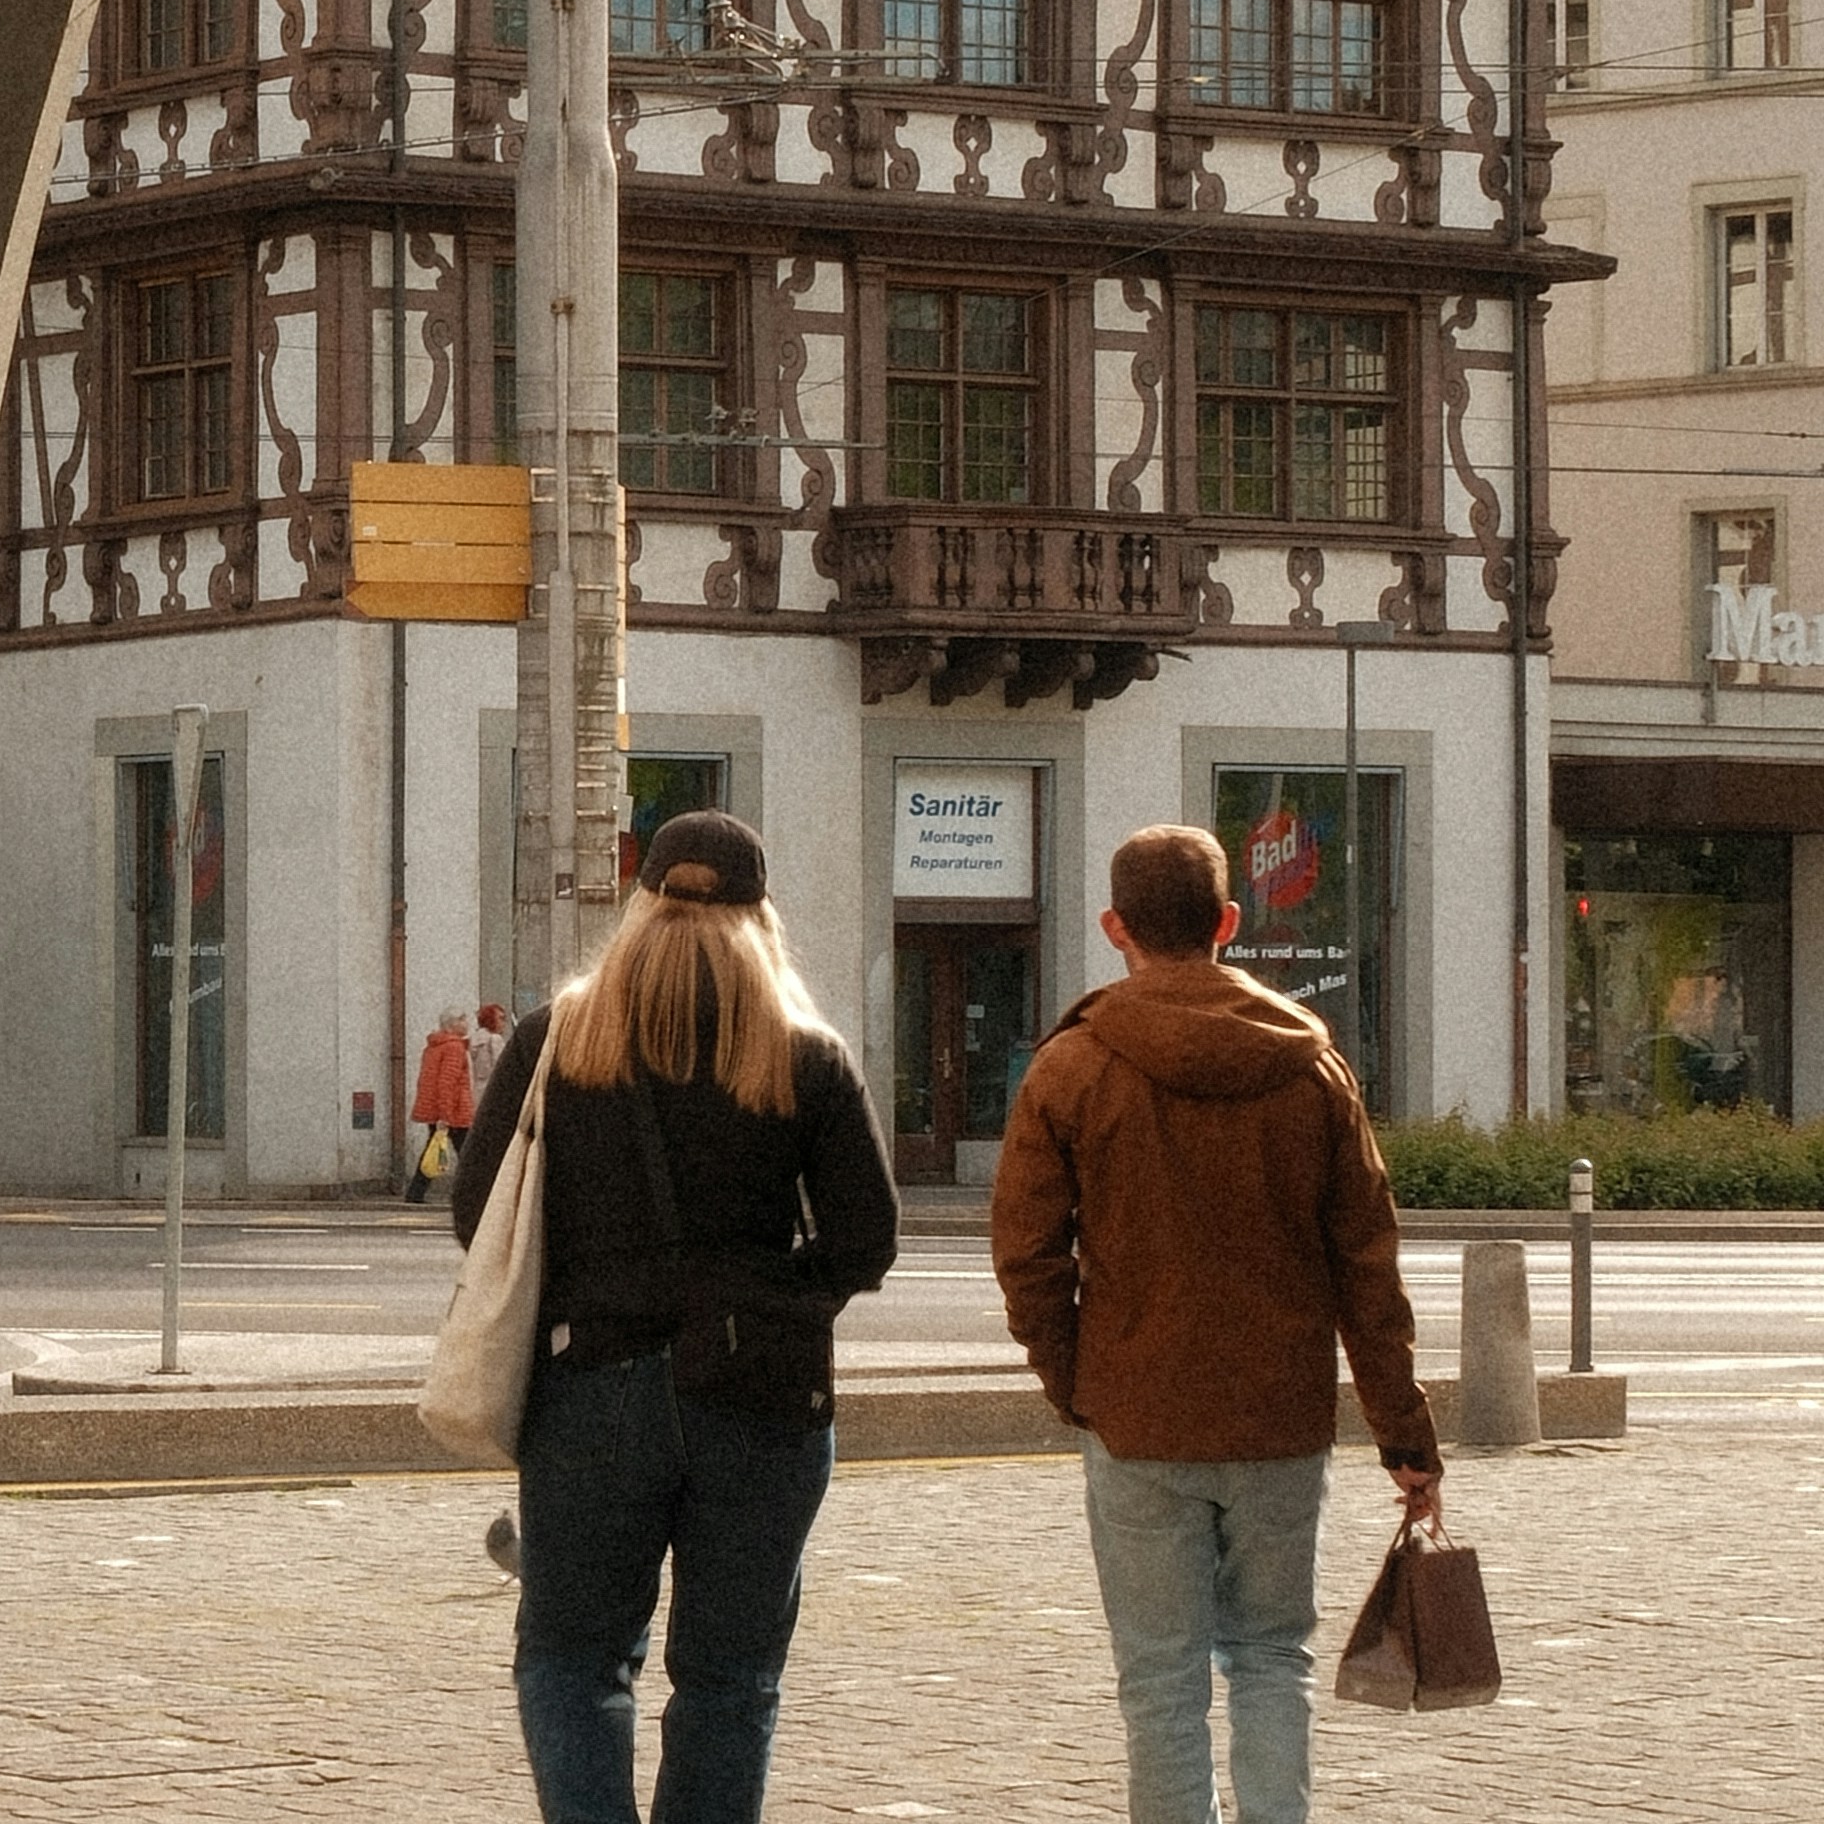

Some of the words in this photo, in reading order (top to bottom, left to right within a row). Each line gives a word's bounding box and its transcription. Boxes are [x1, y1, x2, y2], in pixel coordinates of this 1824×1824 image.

[909, 793, 1003, 817] Sanitär
[919, 829, 994, 847] Montagen
[1251, 819, 1297, 881] Bad
[910, 855, 1003, 871] Reparaturen
[1225, 945, 1257, 959] Alles
[1261, 945, 1293, 959] rund
[1296, 947, 1324, 959] ums
[1327, 945, 1350, 959] Ba
